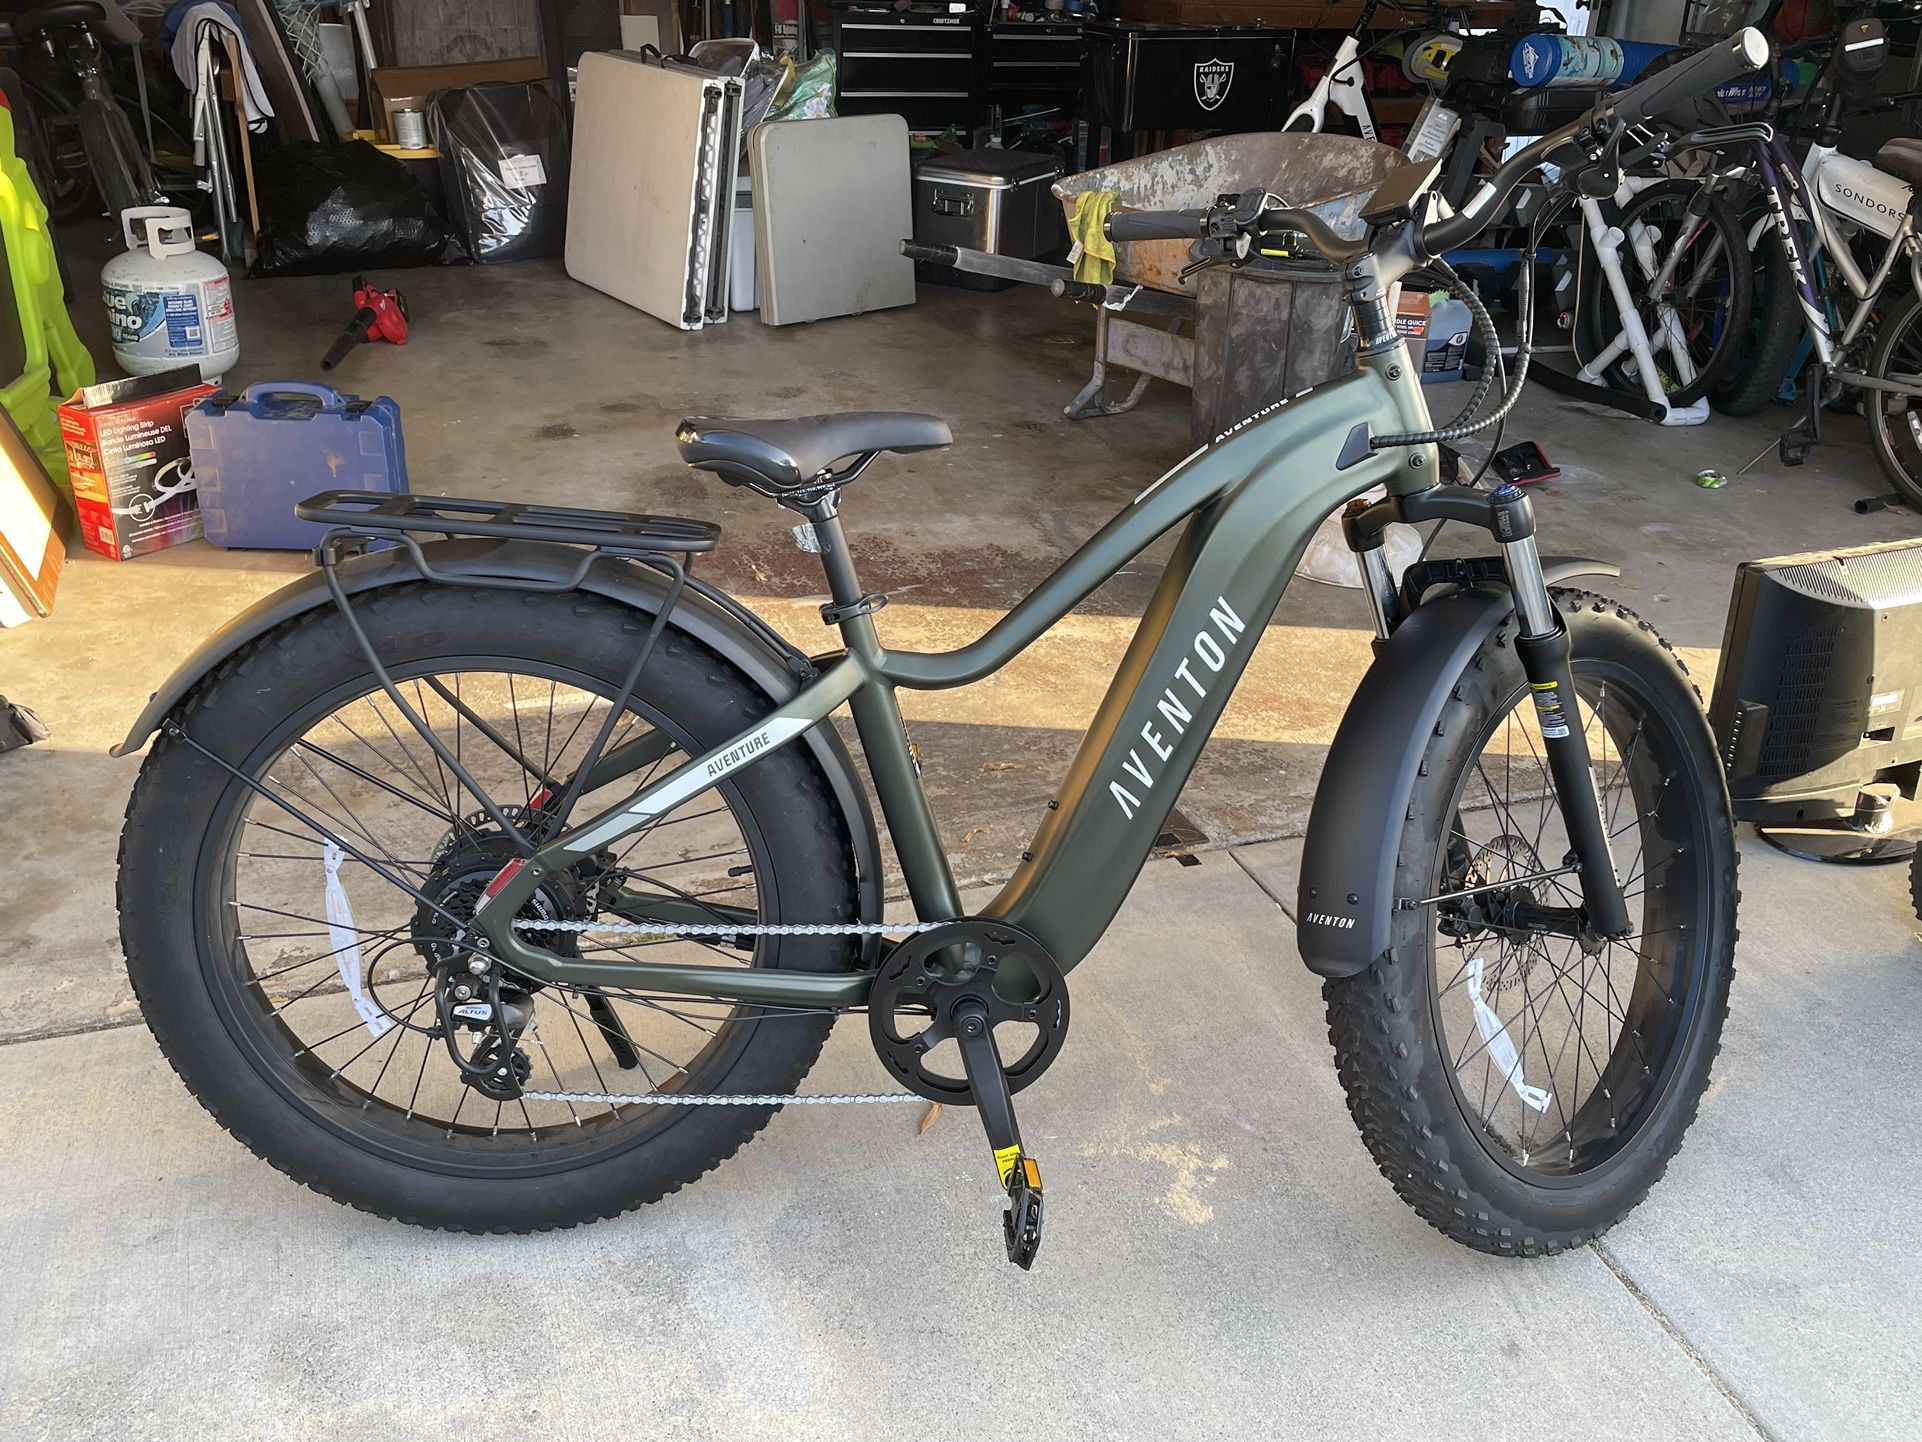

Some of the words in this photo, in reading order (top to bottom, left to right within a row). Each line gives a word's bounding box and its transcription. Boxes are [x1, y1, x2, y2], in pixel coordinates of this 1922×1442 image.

[1199, 65, 1229, 73] RAIDERS
[1834, 183, 1906, 223] SONDORS
[1766, 186, 1808, 286] TREK
[100, 428, 112, 438] LED
[113, 422, 140, 435] Lighting
[140, 420, 155, 430] Strip
[1215, 398, 1289, 443] AVENTURE
[101, 437, 125, 448] Bande
[124, 428, 160, 442] Lumineuse
[160, 424, 173, 433] DEL
[103, 446, 122, 456] Cinta
[122, 438, 154, 452] Luminosa
[154, 435, 166, 444] LED
[1109, 595, 1245, 820] AVENTON
[707, 732, 770, 777] AVENTURE
[531, 898, 549, 921] SHIMA
[1306, 912, 1356, 929] AVENTON
[457, 1007, 488, 1016] ALTUS
